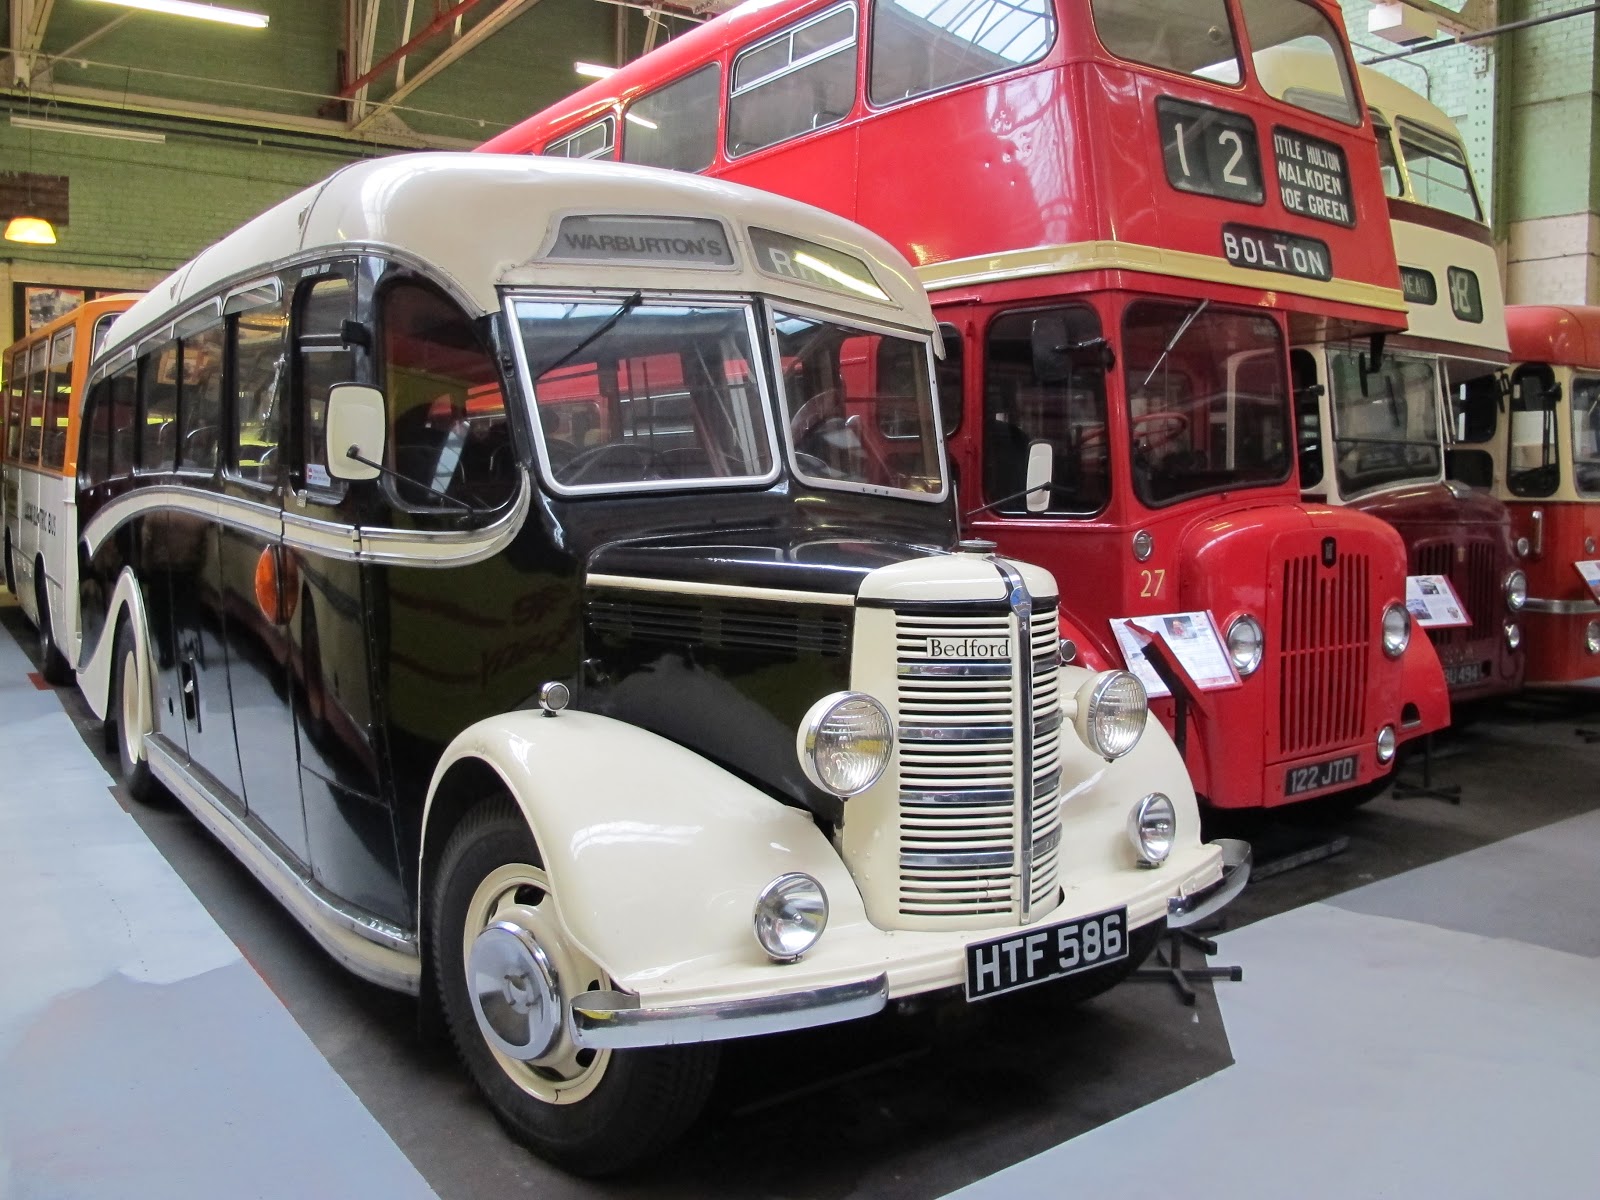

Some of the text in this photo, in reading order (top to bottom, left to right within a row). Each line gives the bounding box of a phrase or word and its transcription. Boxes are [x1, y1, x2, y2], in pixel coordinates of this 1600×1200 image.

[1306, 144, 1340, 172] HULTON
[1308, 193, 1349, 222] GREEN
[564, 233, 723, 257] WARBURTON'S
[1223, 232, 1325, 276] BOLTON
[1140, 568, 1165, 597] 27
[930, 638, 1009, 657] Bedford
[1291, 765, 1319, 792] 122
[975, 913, 1122, 992] HTF 586
